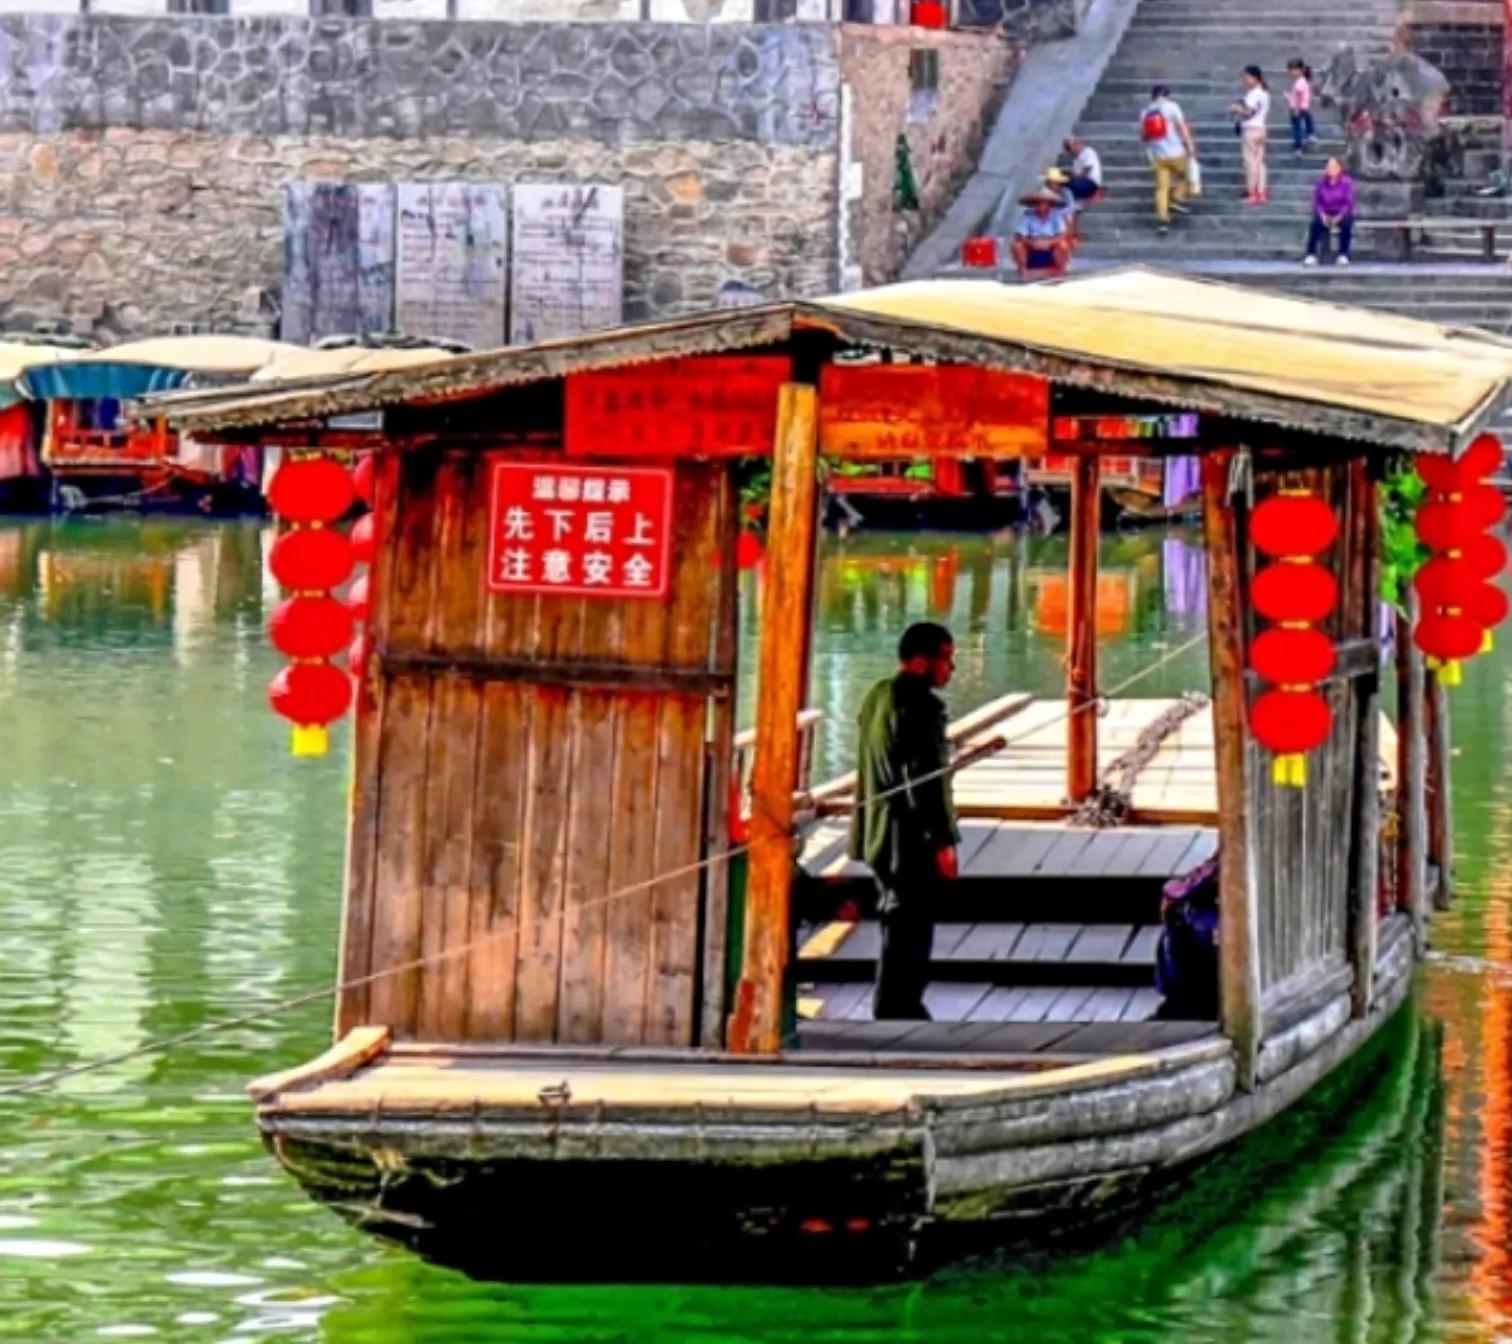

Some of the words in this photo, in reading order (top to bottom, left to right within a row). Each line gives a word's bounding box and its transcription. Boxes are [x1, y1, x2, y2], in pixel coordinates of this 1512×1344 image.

[531, 474, 632, 503] 温馨提示
[502, 505, 656, 547] 先下后上
[500, 546, 654, 587] 注意安全
